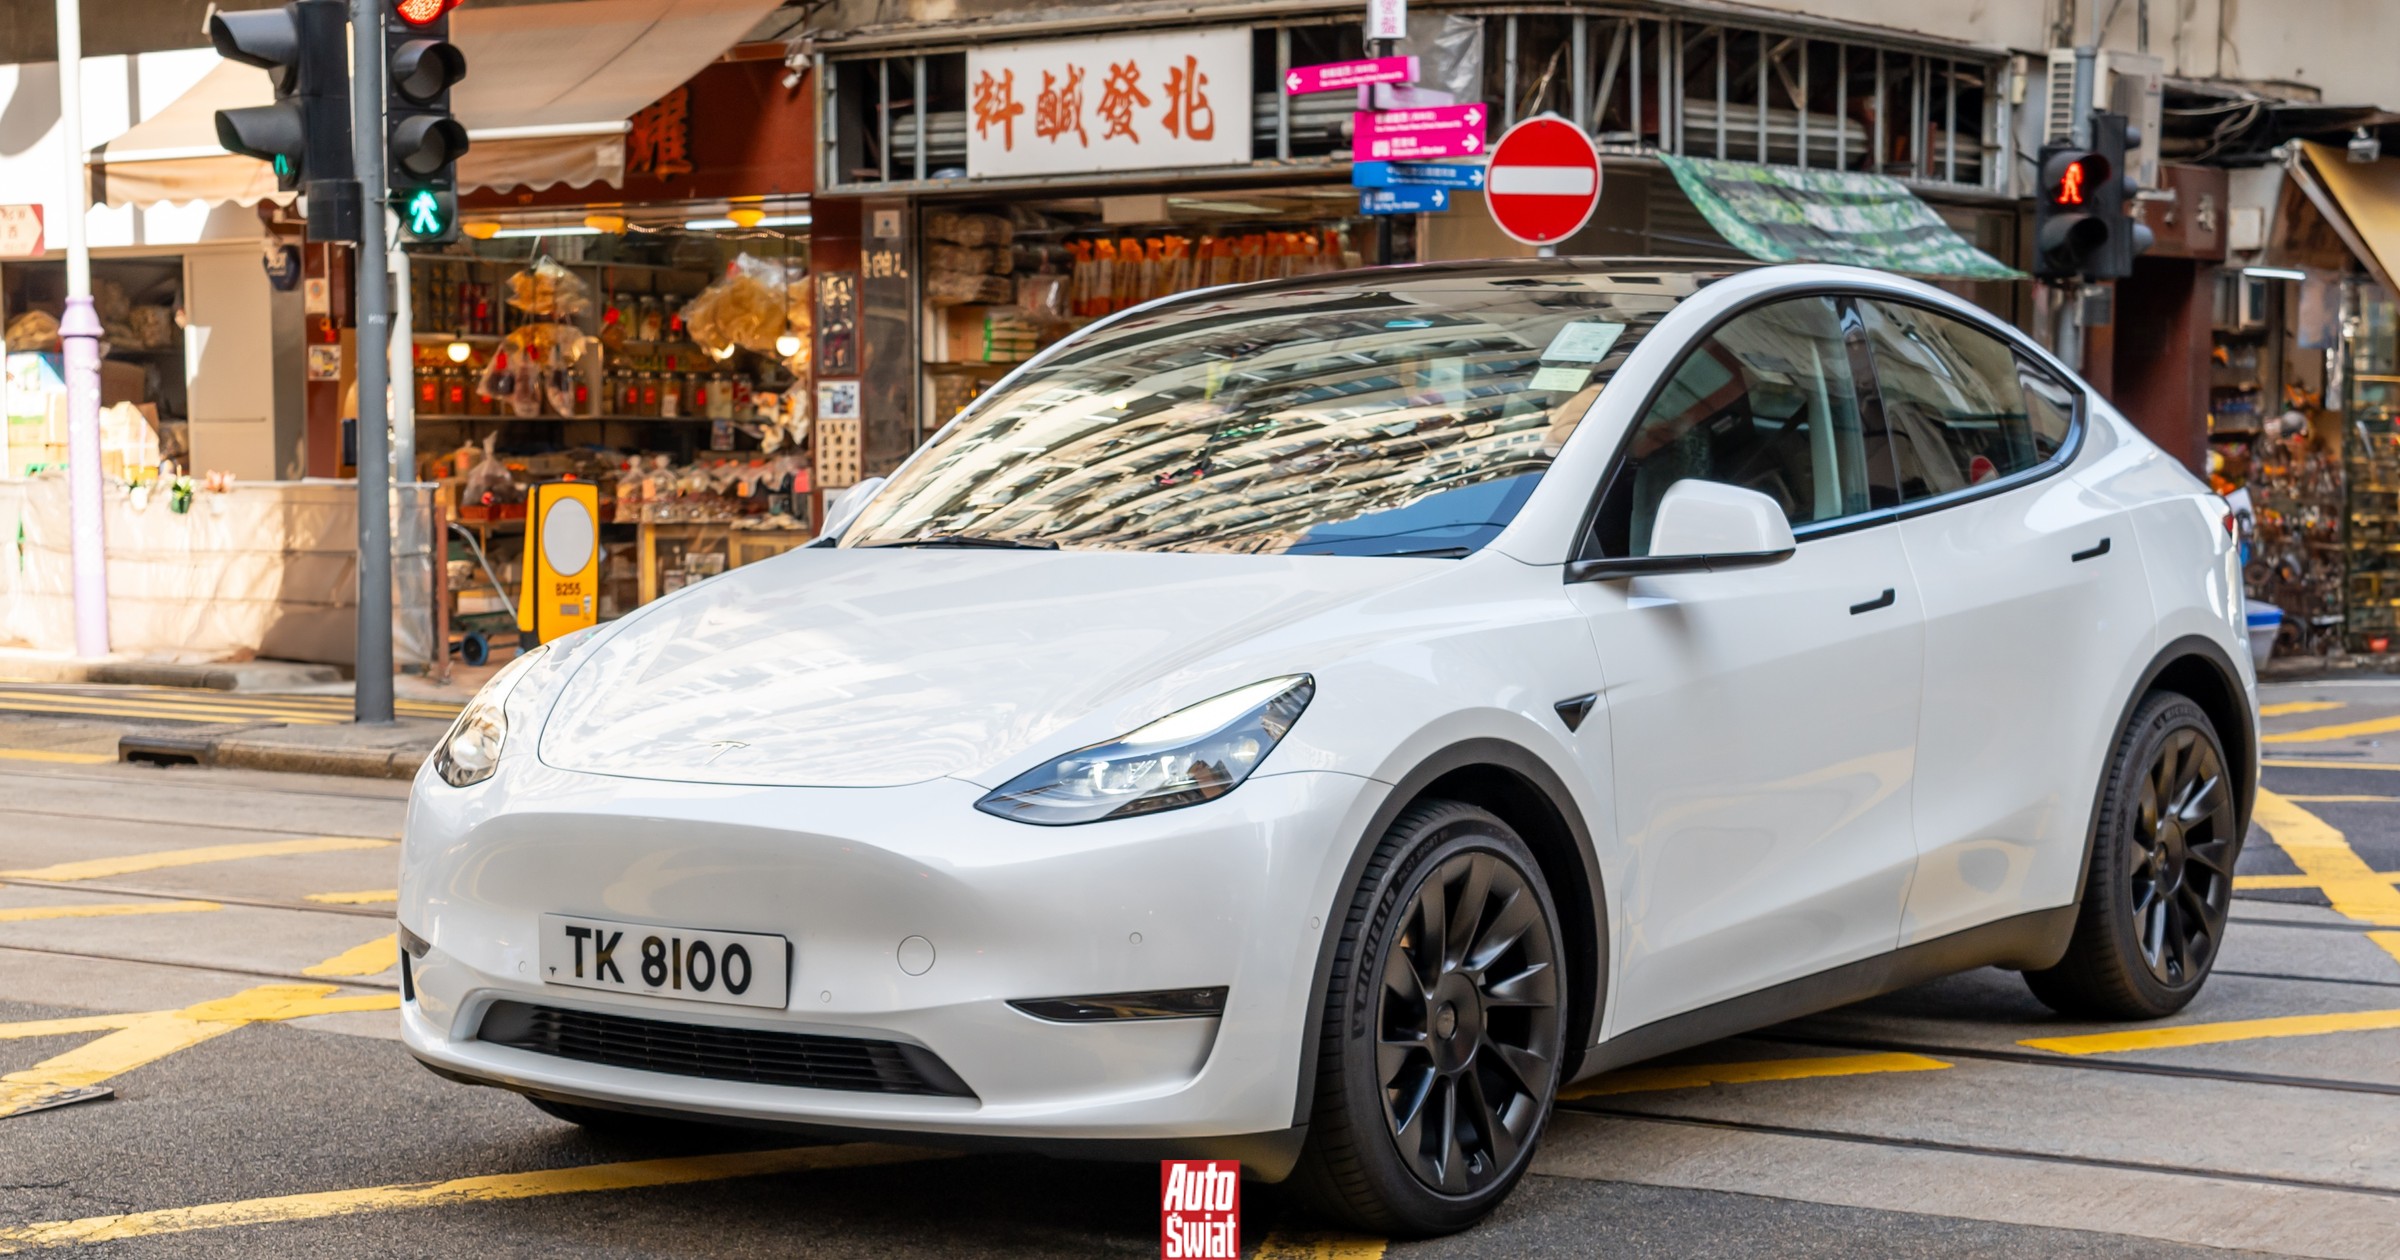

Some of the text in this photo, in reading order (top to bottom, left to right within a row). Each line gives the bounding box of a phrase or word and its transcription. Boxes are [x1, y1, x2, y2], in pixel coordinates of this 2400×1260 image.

[565, 925, 752, 995] TK 8100
[1356, 886, 1396, 1005] MICHELIN
